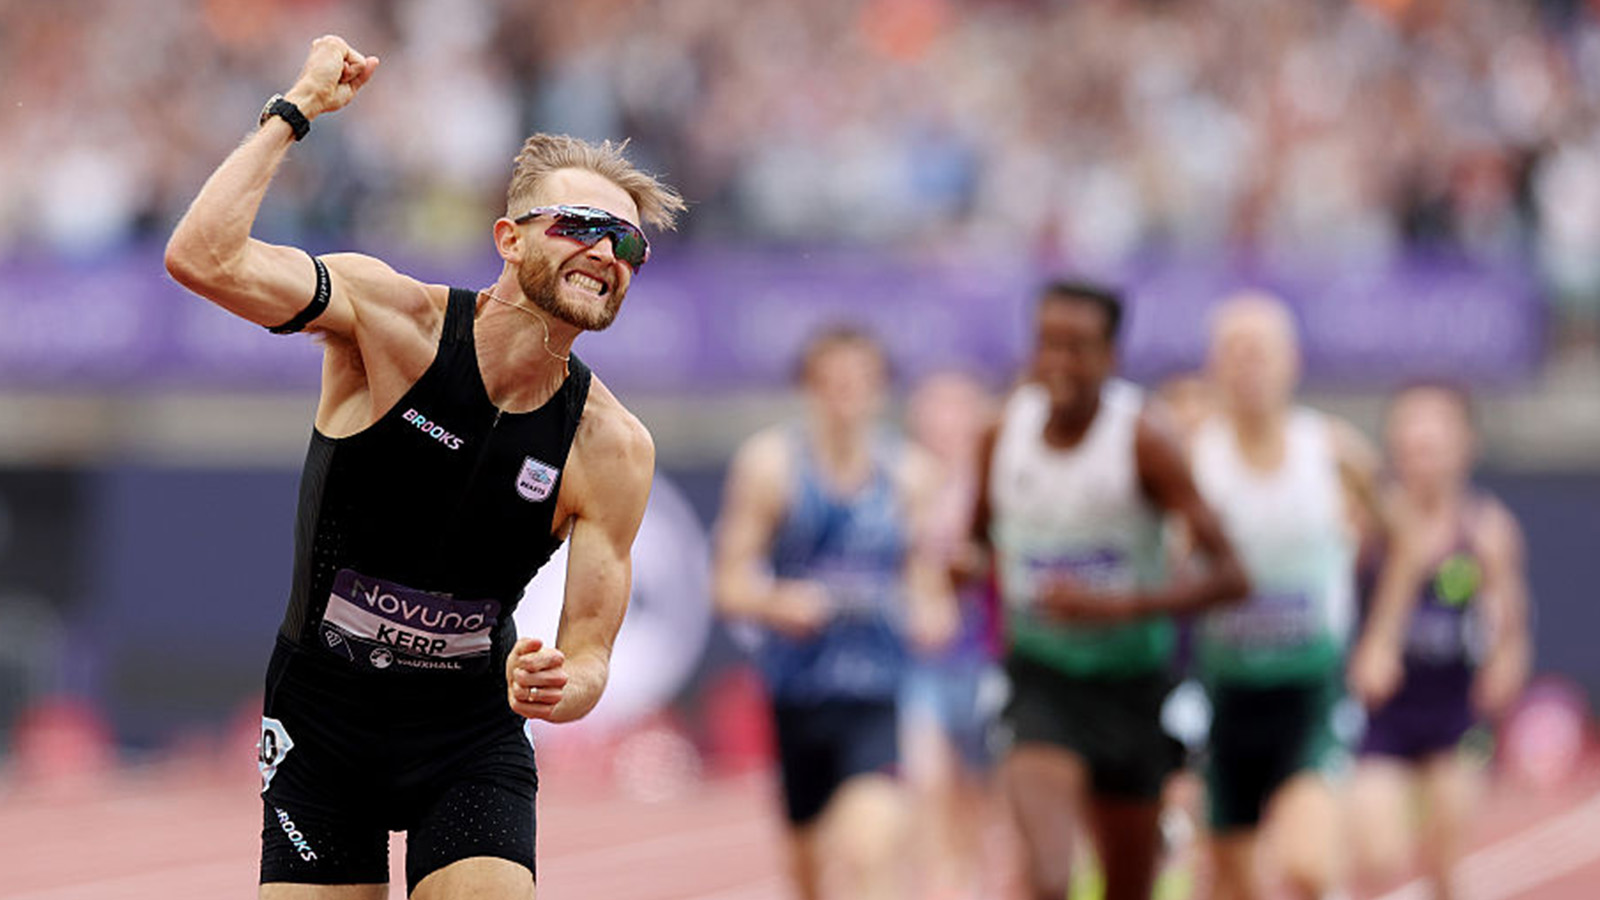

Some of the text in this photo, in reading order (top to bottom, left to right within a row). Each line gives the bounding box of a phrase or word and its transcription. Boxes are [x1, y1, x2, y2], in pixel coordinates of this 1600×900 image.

[402, 408, 464, 450] BROOKS
[351, 578, 484, 630] Novuna
[376, 623, 447, 654] KERR
[396, 658, 462, 670] VAUXHALL
